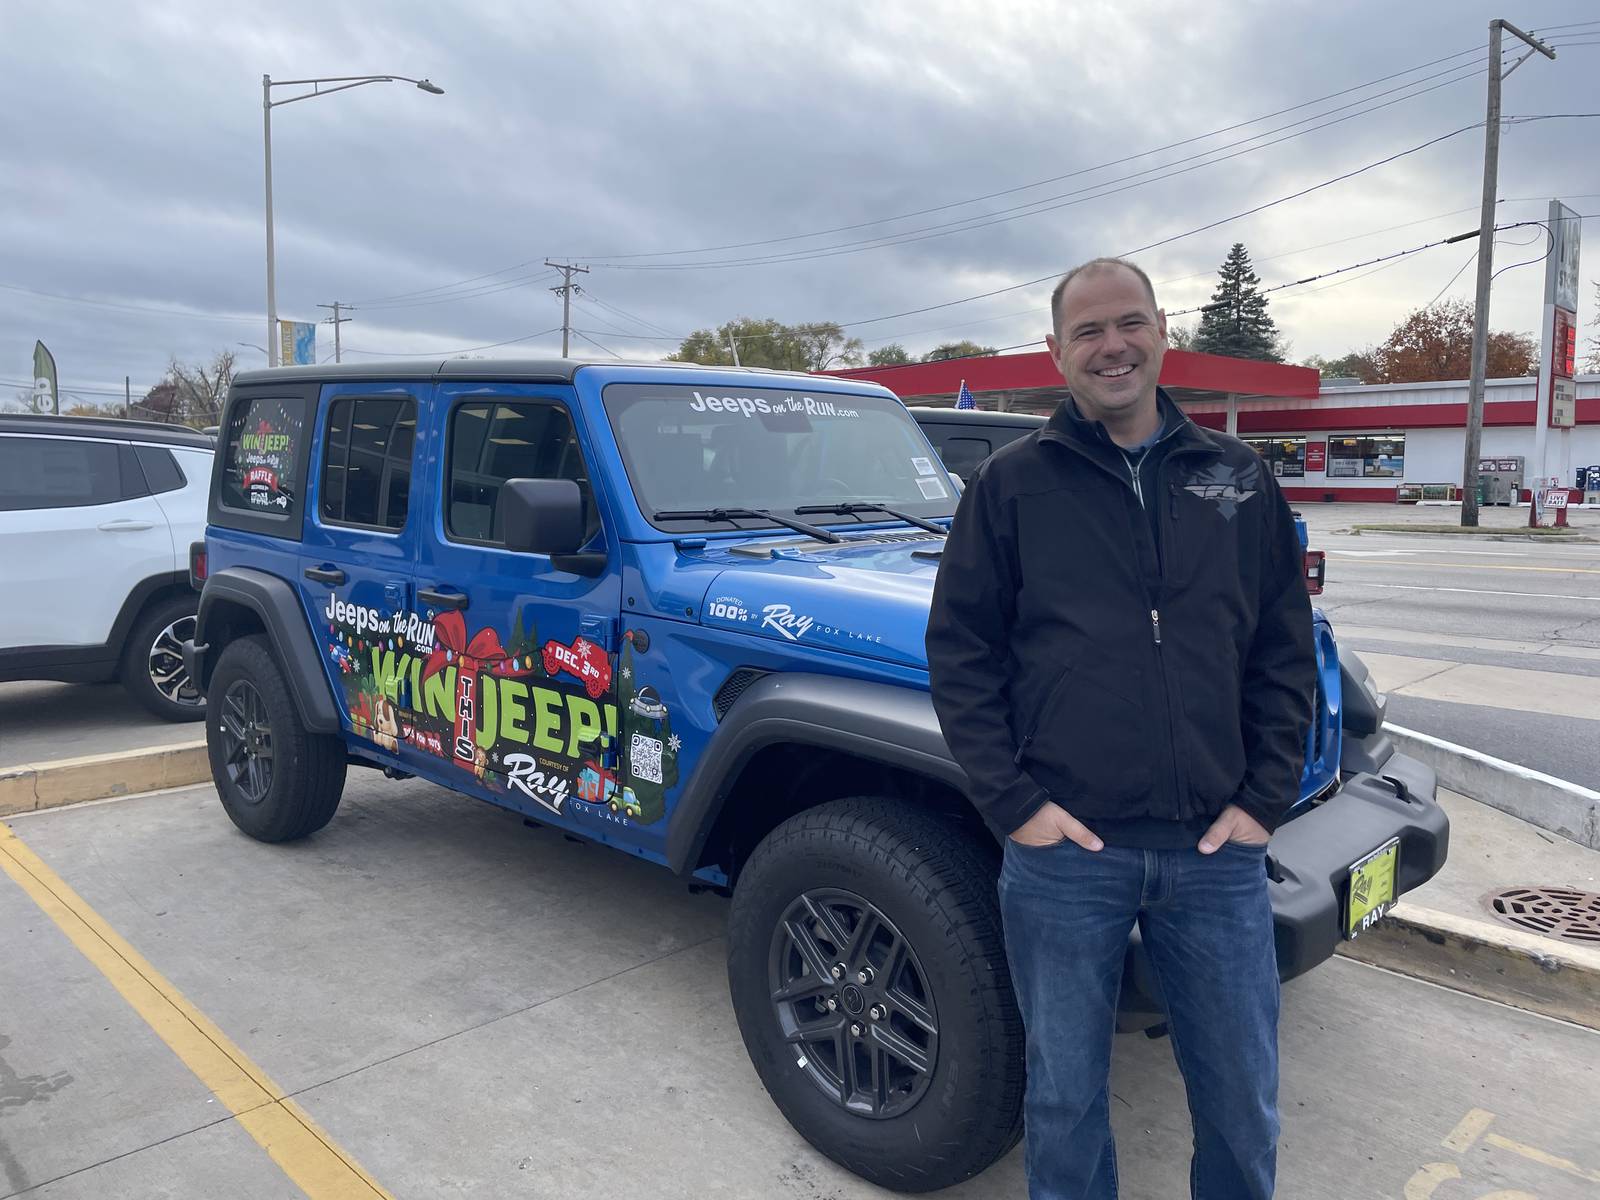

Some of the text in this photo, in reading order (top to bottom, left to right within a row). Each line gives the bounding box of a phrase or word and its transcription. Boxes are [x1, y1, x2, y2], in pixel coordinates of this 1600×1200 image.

[690, 391, 771, 418] Jeeps
[772, 404, 787, 414] on
[785, 396, 804, 412] the
[243, 433, 260, 450] WIN
[250, 470, 273, 483] RAFFLE
[709, 602, 748, 622] 100%
[716, 596, 743, 607] DONATED
[325, 592, 435, 647] Jeeps on the RUN
[761, 604, 881, 643] Ray FOX LAKE
[555, 646, 600, 679] DEC. 3RD
[372, 646, 457, 723] WIN
[455, 675, 475, 761] THIS
[539, 757, 562, 770] COURTESY
[503, 752, 570, 815] Ray
[598, 810, 629, 826] LAKE
[1362, 903, 1385, 931] RAY
